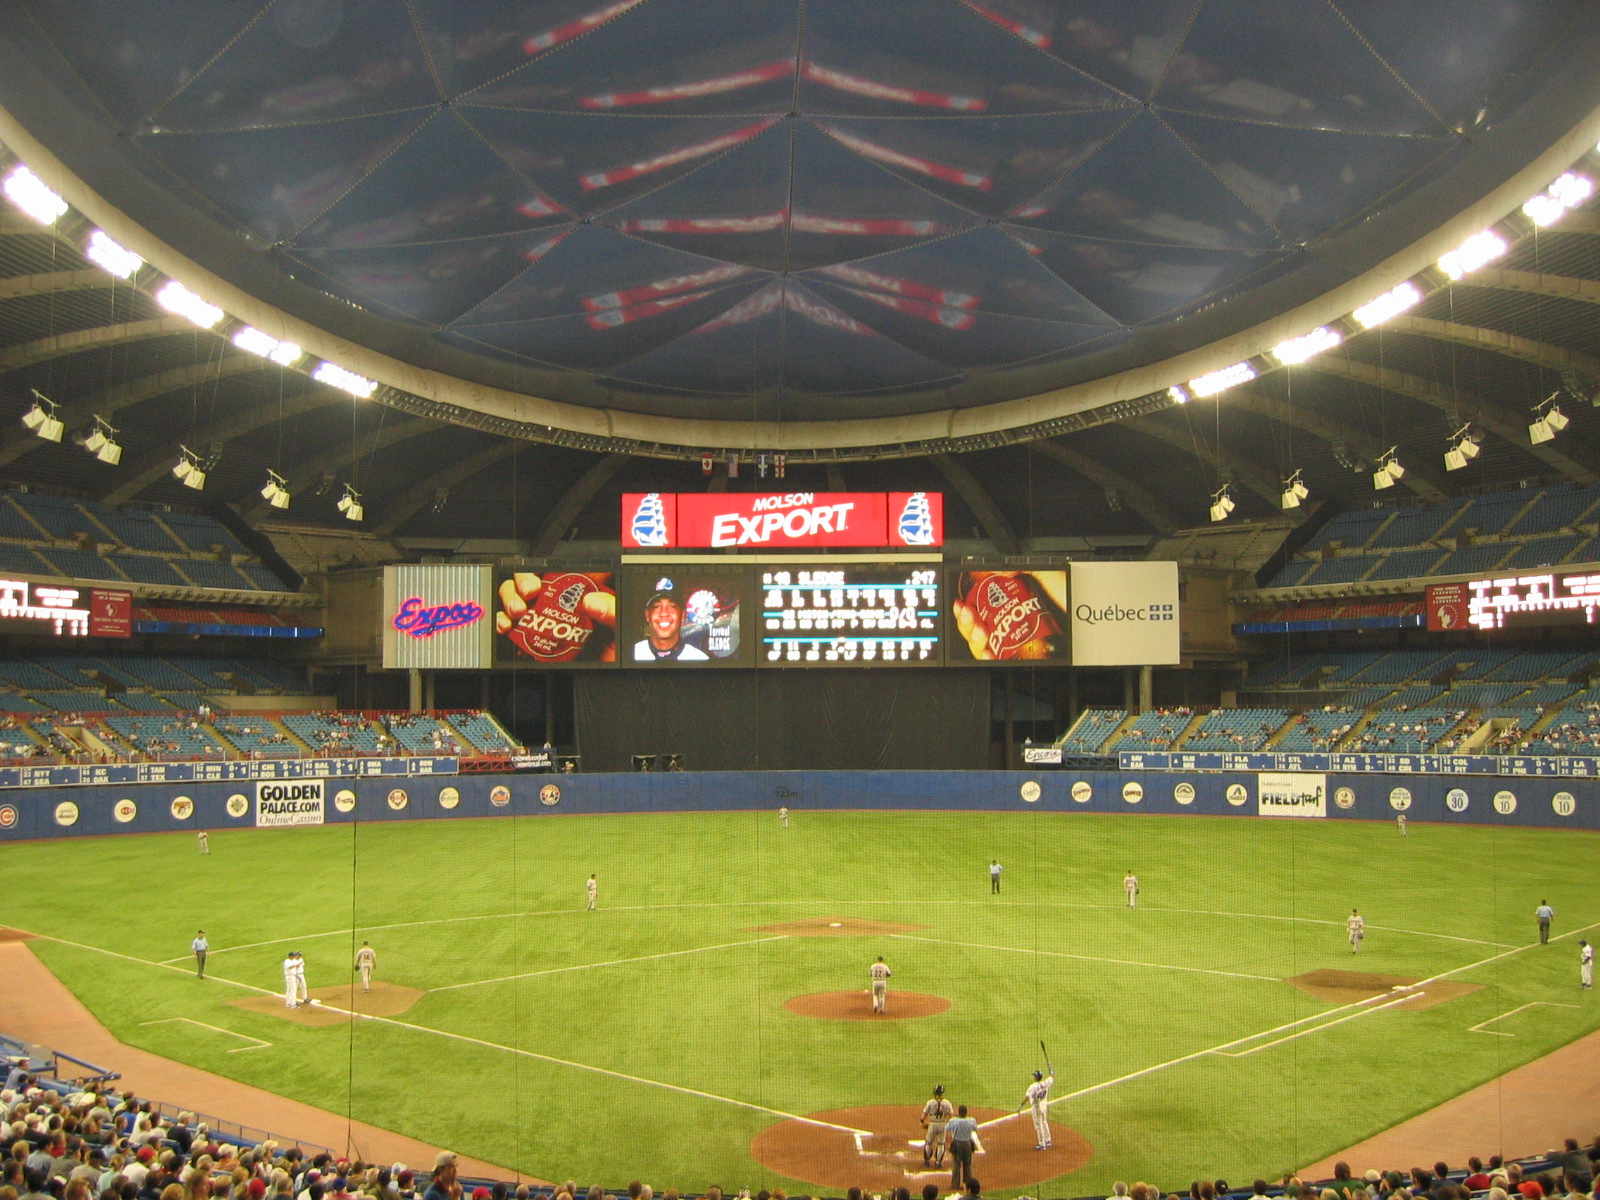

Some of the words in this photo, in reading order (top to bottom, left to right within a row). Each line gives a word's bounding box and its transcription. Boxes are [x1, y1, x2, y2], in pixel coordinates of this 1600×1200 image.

[753, 492, 814, 511] MOLSON
[711, 503, 854, 548] EXPORT
[393, 597, 483, 636] Expos
[542, 607, 580, 624] MOLSON
[993, 597, 1020, 625] MOLSON
[1076, 603, 1146, 624] Québec
[518, 609, 593, 643] EXPORT
[989, 597, 1041, 655] EXPORT
[260, 784, 321, 801] GOLDEN
[260, 802, 320, 814] PALACE.COM
[1451, 797, 1464, 808] 30
[1500, 801, 1510, 812] 10
[1559, 801, 1570, 813] 10
